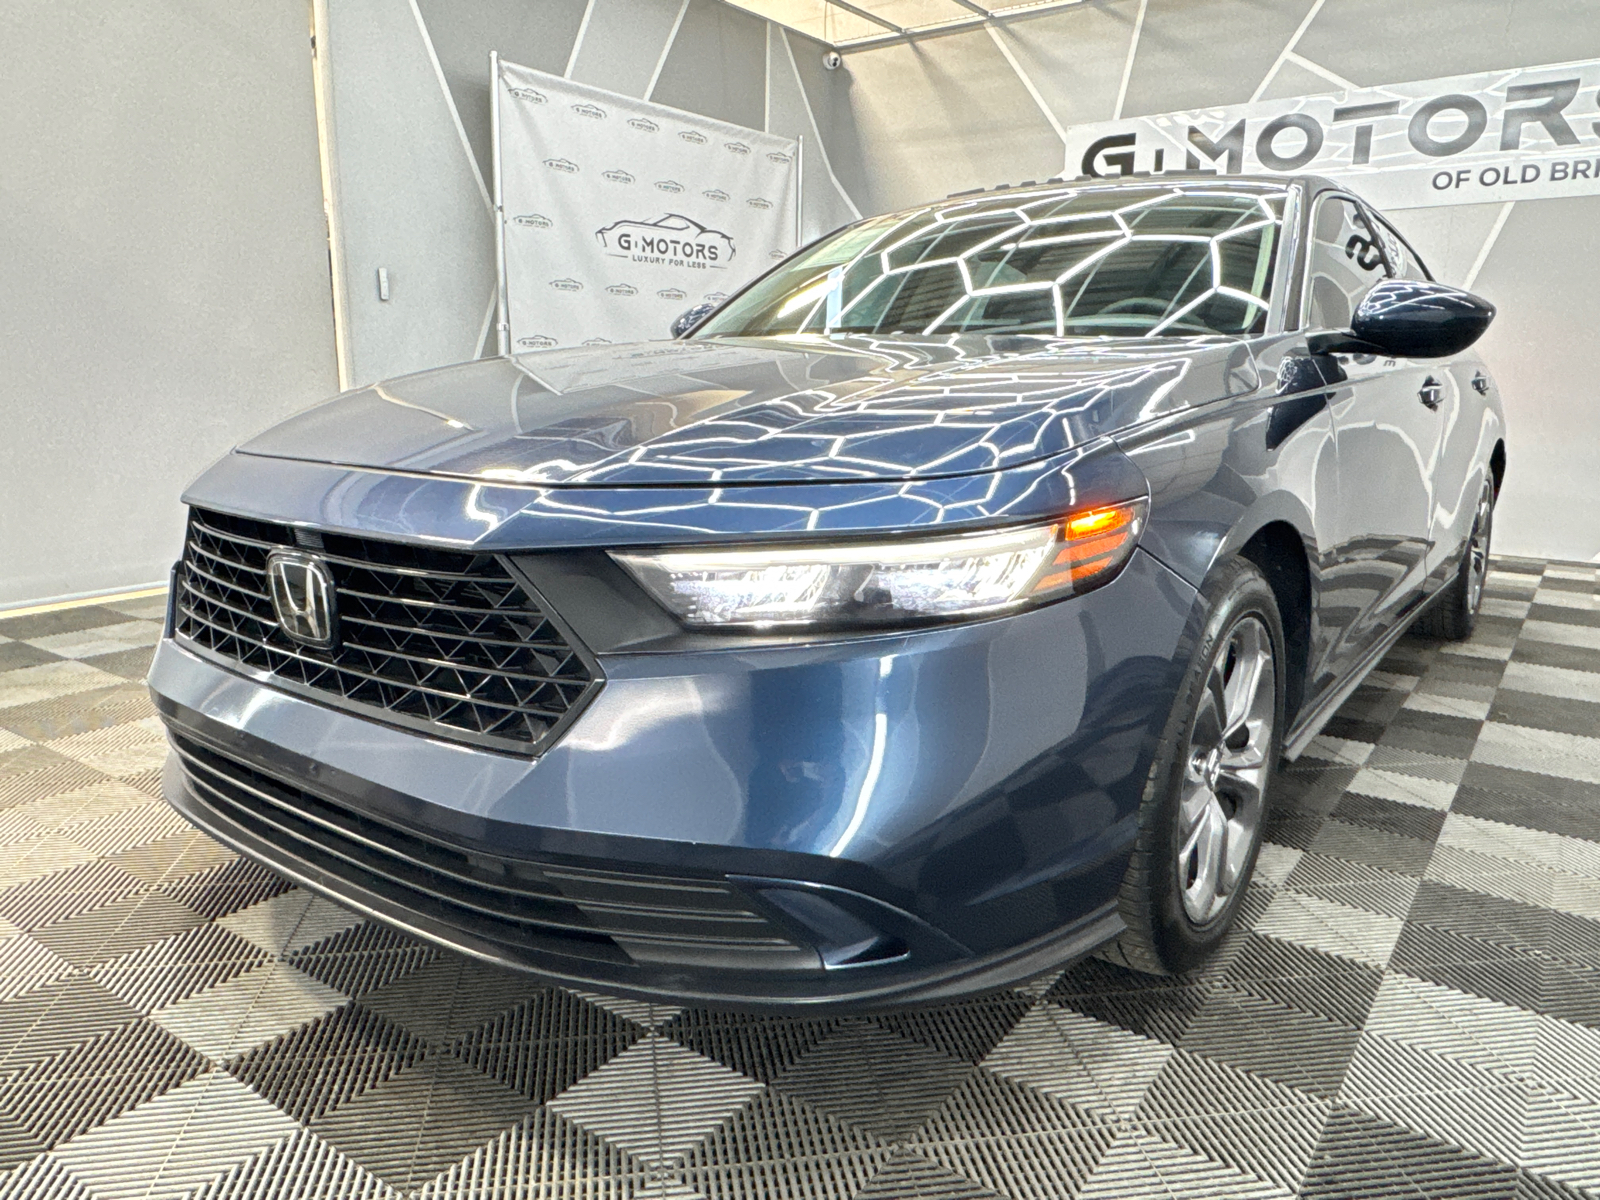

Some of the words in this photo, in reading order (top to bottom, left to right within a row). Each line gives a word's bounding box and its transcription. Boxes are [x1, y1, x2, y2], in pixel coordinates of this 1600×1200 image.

[1186, 77, 1600, 175] MOTOR
[1432, 169, 1471, 191] OF
[1479, 163, 1541, 187] OLD
[641, 235, 719, 261] MOTORS
[632, 254, 666, 265] LUXURY
[668, 259, 685, 267] FOR
[687, 261, 707, 270] LESS
